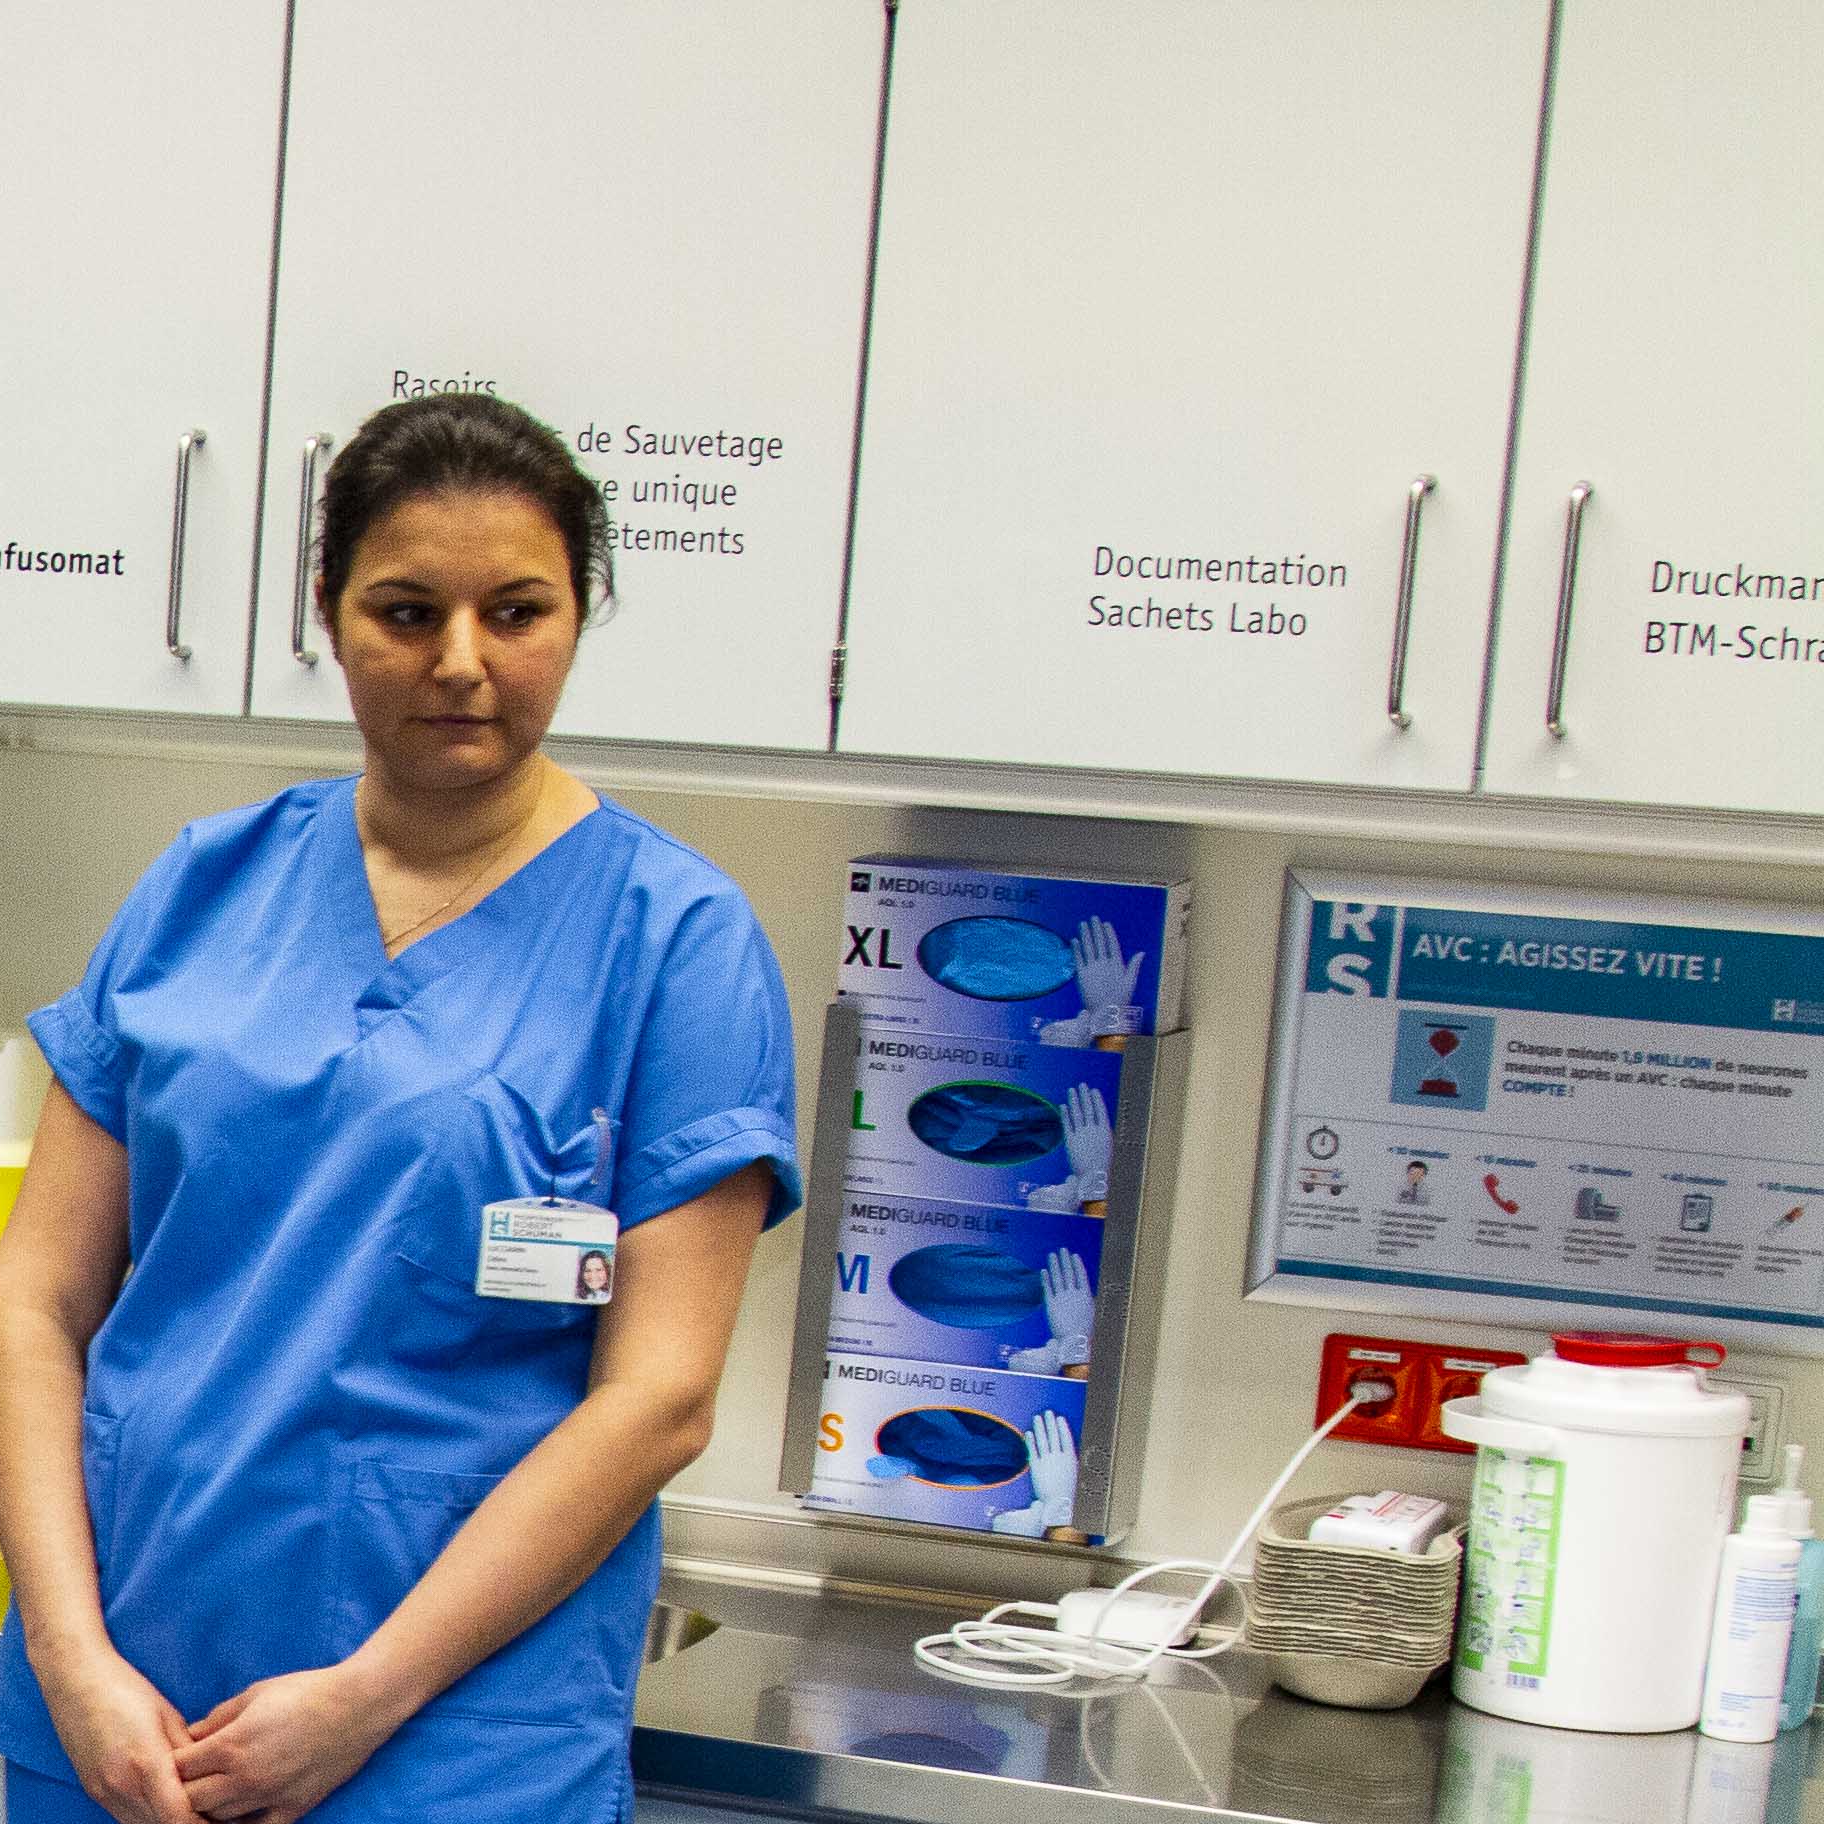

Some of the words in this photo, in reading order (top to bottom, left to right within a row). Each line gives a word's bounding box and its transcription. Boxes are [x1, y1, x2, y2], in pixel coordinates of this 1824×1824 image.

[577, 423, 611, 453] de
[624, 424, 783, 467] Sauvetage
[632, 474, 737, 512] unique
[608, 520, 744, 554] êtements
[1093, 545, 1348, 589] Documentation
[1087, 595, 1214, 633] Sachets
[1230, 602, 1308, 637] Labo
[878, 876, 988, 902] MEDIGUARD
[993, 883, 1042, 904] BLUE
[844, 925, 903, 970] XL
[1412, 934, 1473, 960] AVC
[1496, 939, 1627, 974] AGISSEZ
[1636, 951, 1705, 982] VITE
[869, 1041, 978, 1067] MEDIGUARD
[983, 1051, 1028, 1070] BLUE
[1507, 1040, 1563, 1058] Chaque
[1647, 1053, 1713, 1069] MILLION
[1502, 1079, 1566, 1097] COMPTE
[853, 1089, 877, 1131] L
[851, 1203, 959, 1229] MEDIGUARD
[963, 1213, 1010, 1234] BLUE
[838, 1364, 945, 1391] MEDIGUARD
[950, 1376, 997, 1397] BLUE
[817, 1413, 845, 1452] S
